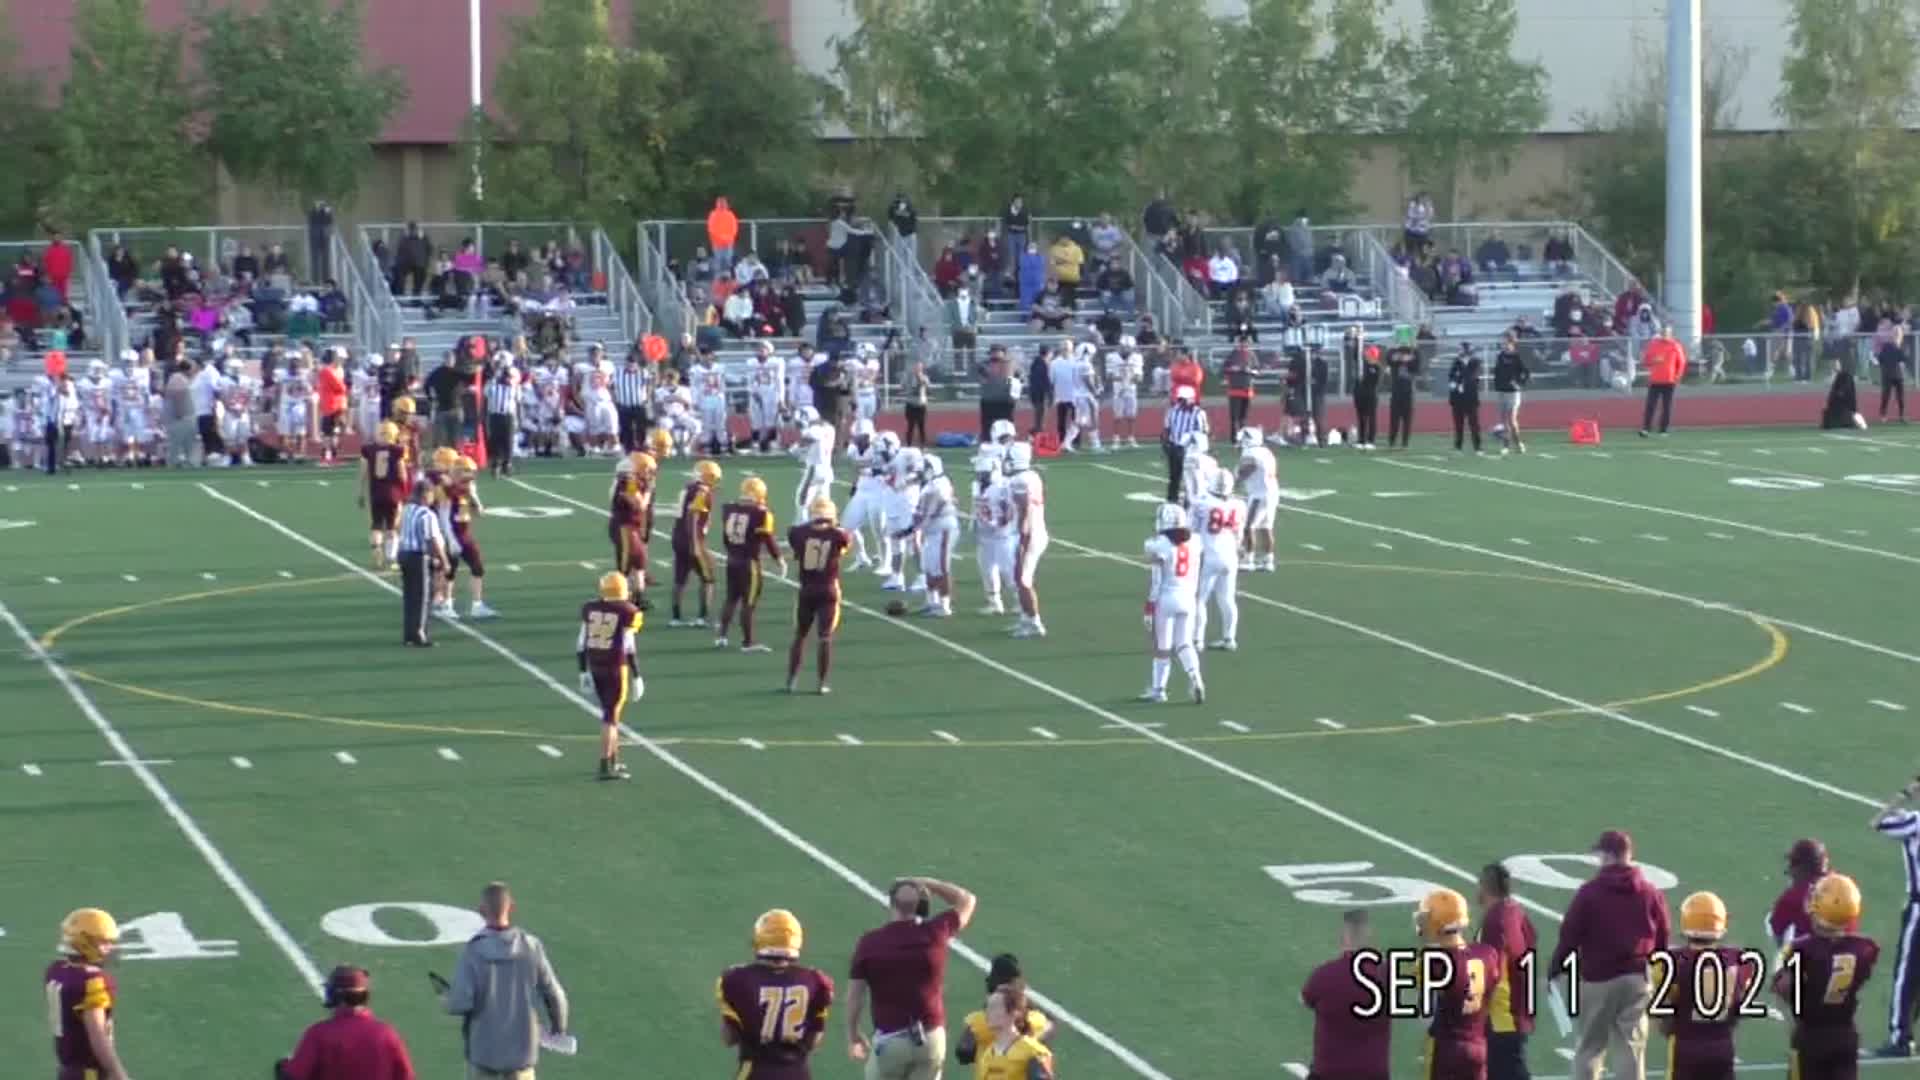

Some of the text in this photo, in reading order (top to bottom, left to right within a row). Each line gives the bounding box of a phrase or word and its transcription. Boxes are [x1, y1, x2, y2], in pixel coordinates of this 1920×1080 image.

[1208, 508, 1239, 535] 84
[803, 537, 832, 571] 61
[1175, 542, 1190, 578] 8
[1823, 953, 1857, 1005] 2
[759, 984, 809, 1042] 72
